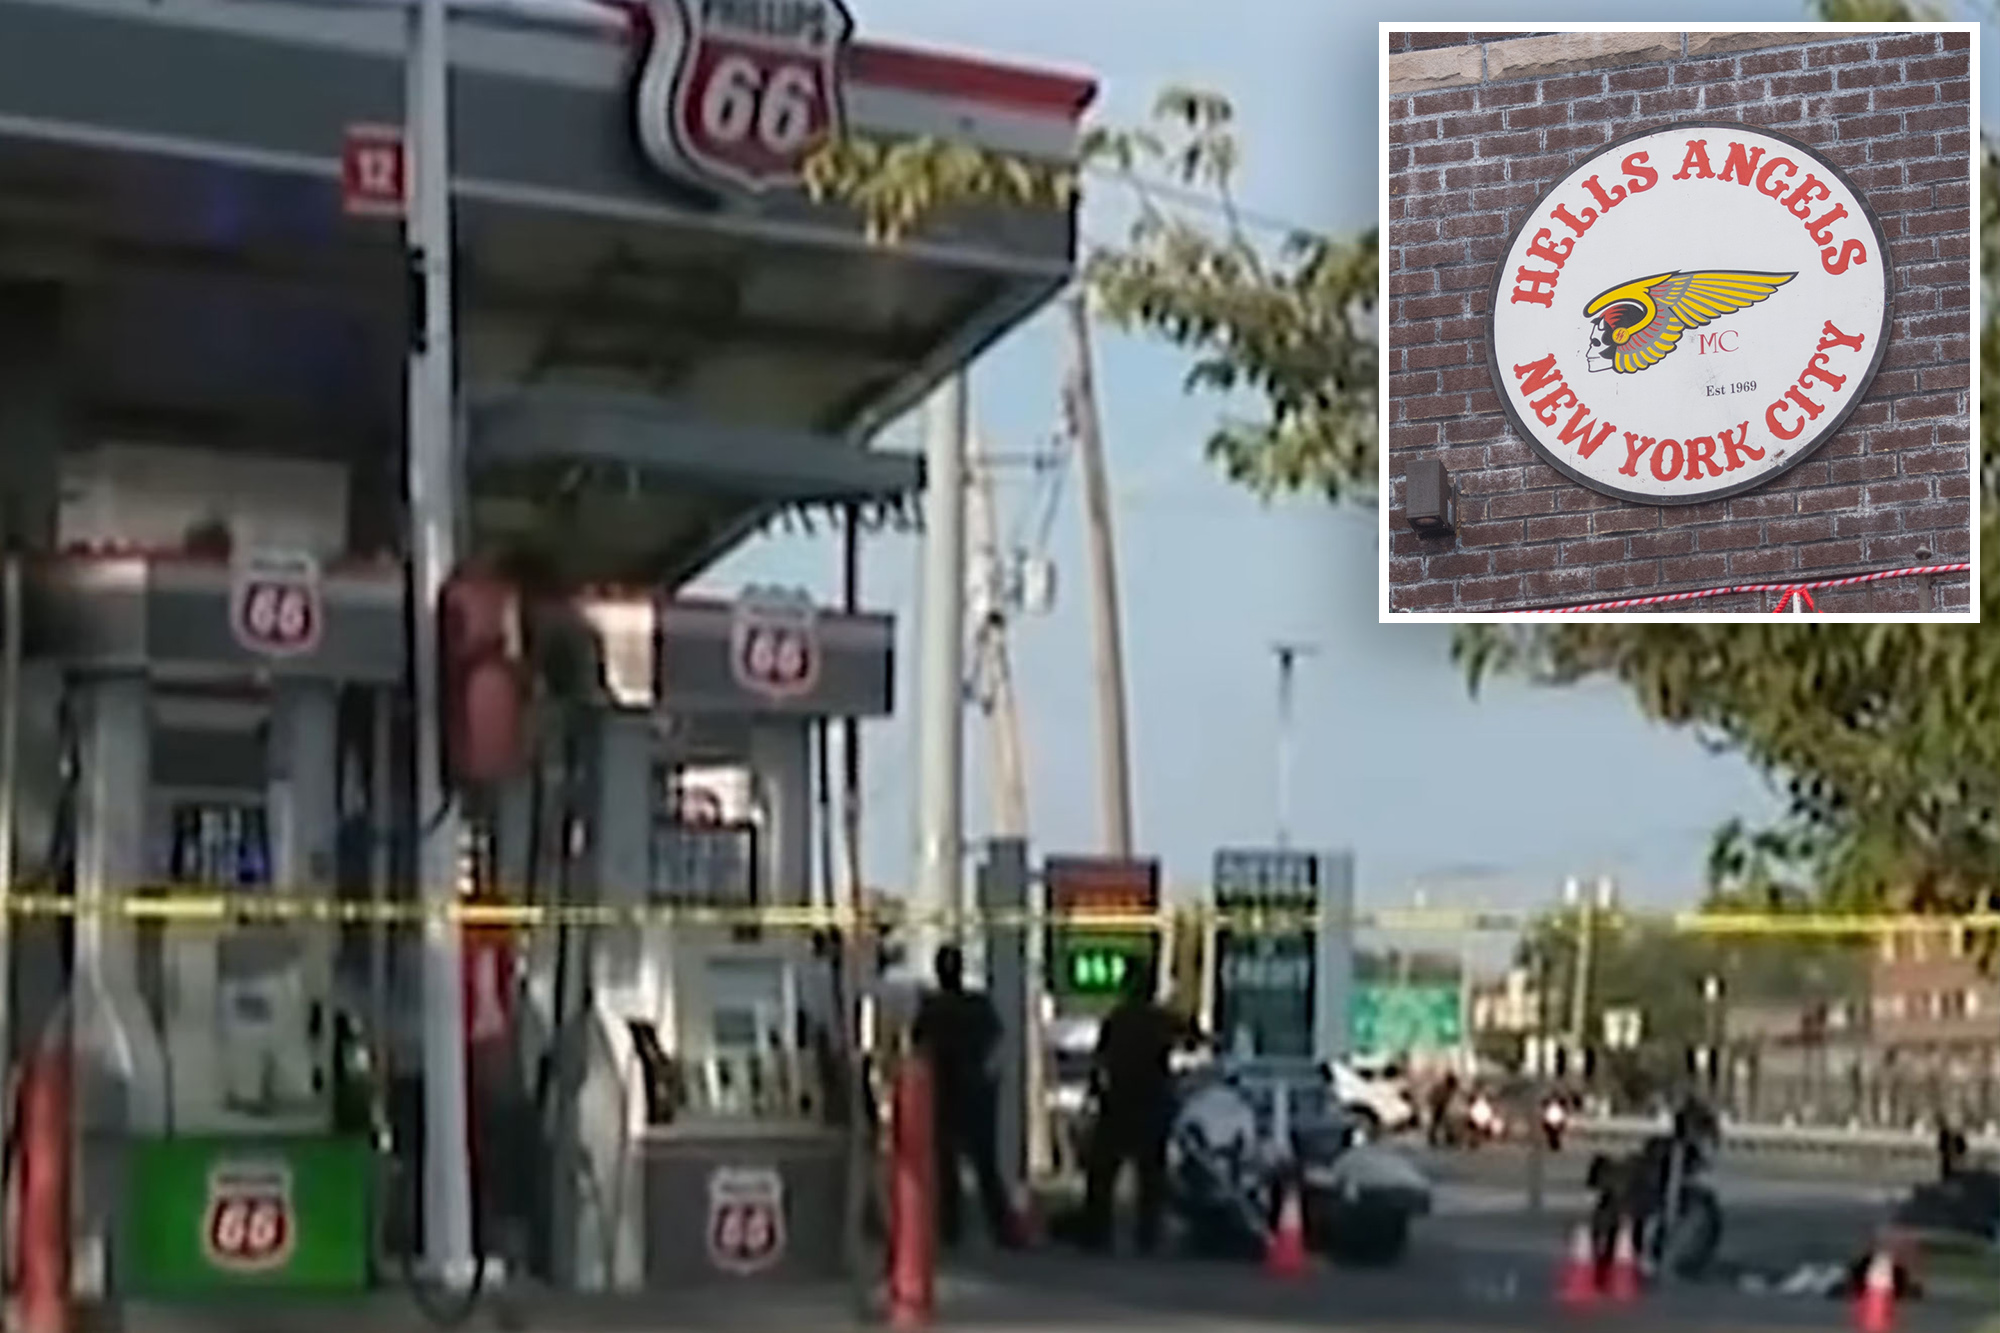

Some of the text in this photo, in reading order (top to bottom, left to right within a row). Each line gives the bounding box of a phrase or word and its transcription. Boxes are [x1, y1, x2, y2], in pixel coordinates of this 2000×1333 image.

[701, 56, 817, 152] 66
[1511, 139, 1867, 308] HELLS ANGELS
[1698, 330, 1739, 355] MC
[1513, 320, 1865, 482] NEW YORK CITY
[1706, 380, 1757, 397] Est 1969
[250, 588, 304, 636] 66
[751, 633, 801, 676] 66
[217, 1201, 278, 1251] 66
[721, 1208, 768, 1251] 66
